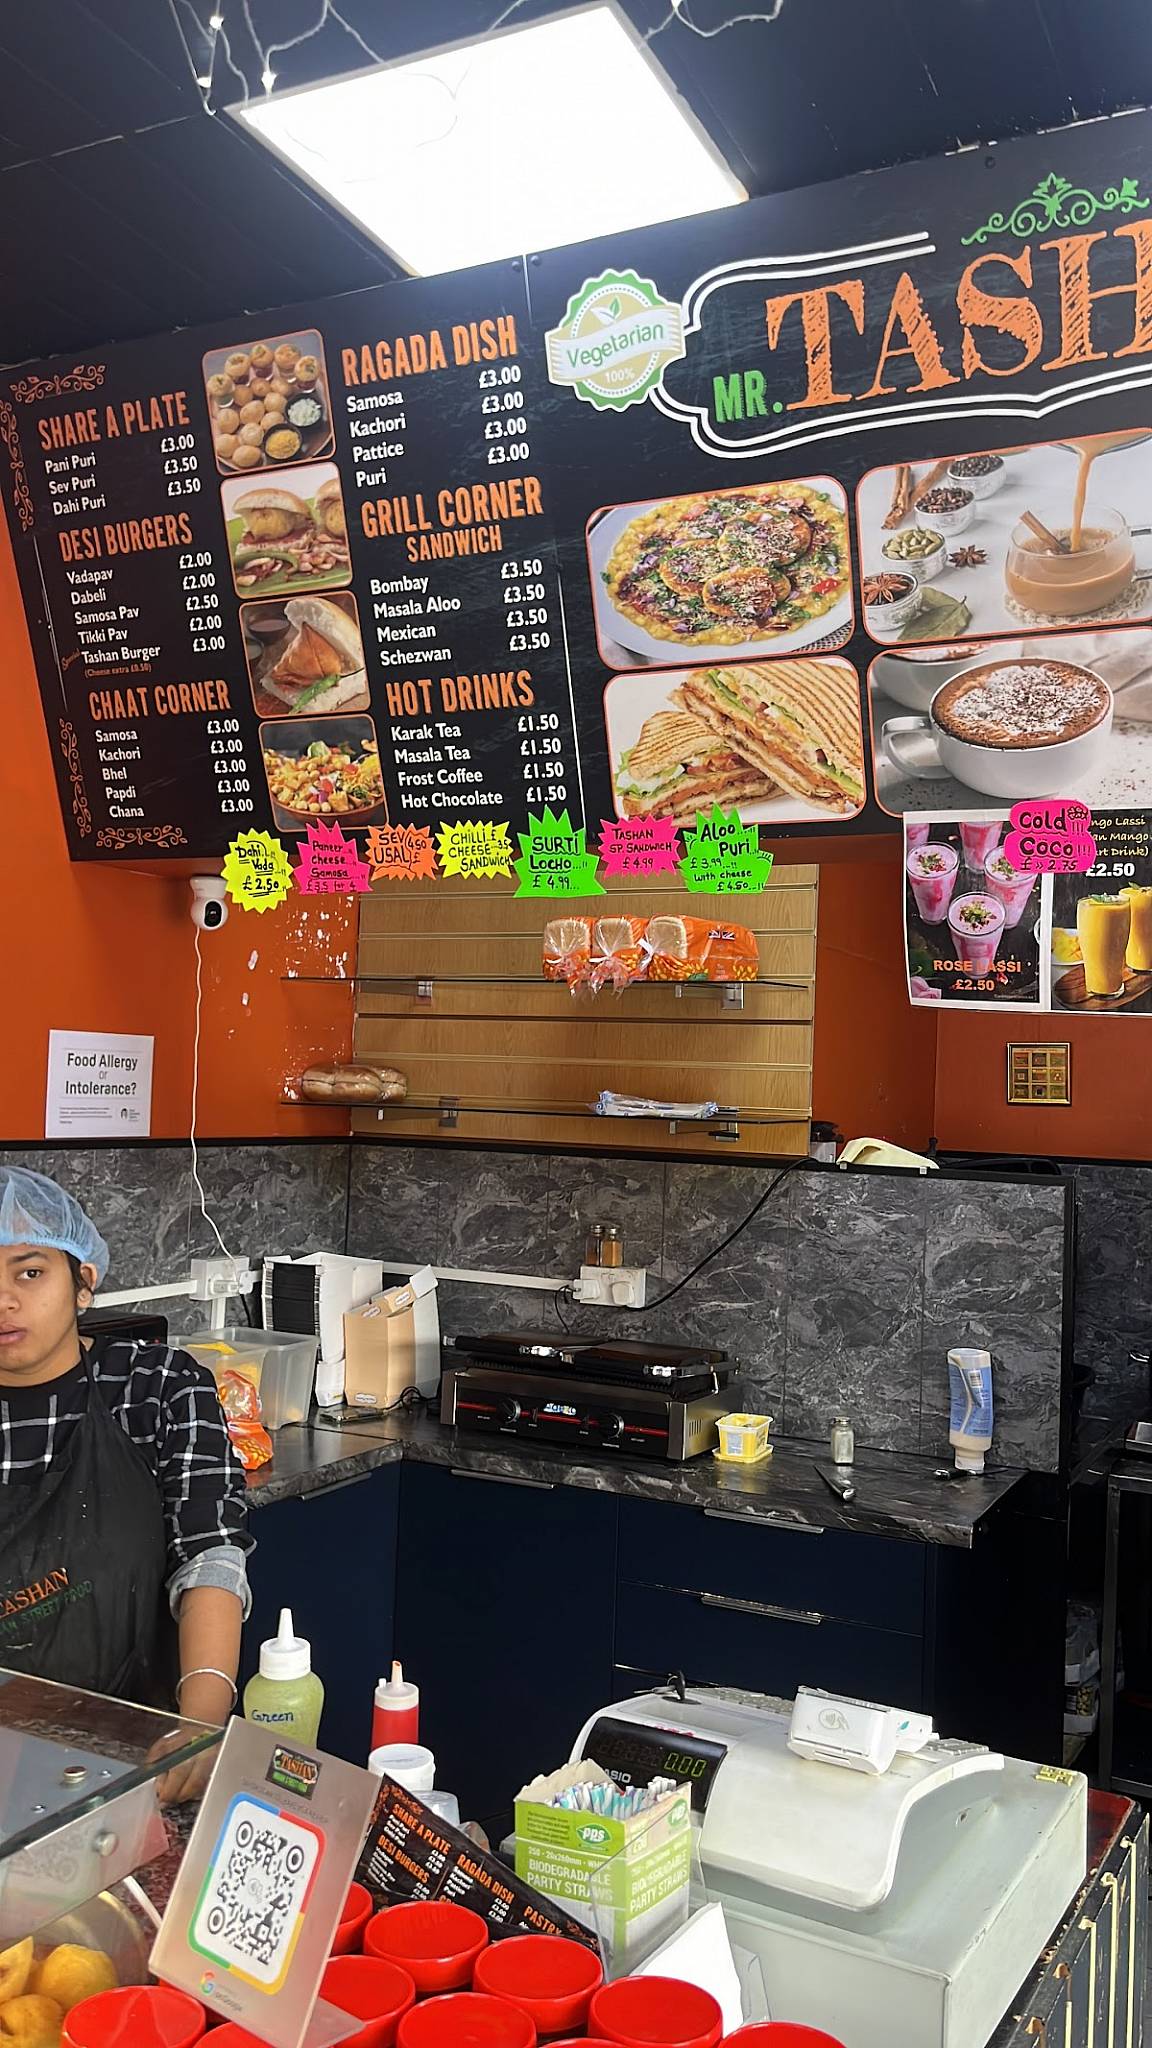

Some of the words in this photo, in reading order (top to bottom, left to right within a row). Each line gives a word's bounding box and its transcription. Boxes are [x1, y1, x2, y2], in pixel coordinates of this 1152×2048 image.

[341, 330, 448, 387] RAGADA
[452, 315, 518, 366] DISH
[568, 324, 664, 368] Vegetarian
[479, 365, 521, 389] £3.00
[605, 368, 635, 383] 100%
[346, 391, 404, 413] Samosa
[482, 391, 524, 415] £3.00
[712, 368, 784, 424] MR.
[37, 408, 101, 450] SHARE
[107, 406, 120, 438] A
[122, 391, 190, 436] PLATE
[350, 413, 407, 438] Kachori
[485, 417, 527, 440] £3.00
[161, 434, 195, 452] £3.00
[353, 442, 404, 463] Pattice
[45, 459, 70, 474] Pani
[72, 452, 97, 471] Puri
[488, 442, 530, 465] £3.00
[164, 456, 198, 475] £3.50
[49, 481, 70, 495] Sev
[72, 475, 96, 491] Puri
[168, 478, 201, 496] £3.50
[356, 468, 387, 488] Puri
[53, 499, 80, 516] Dahi
[81, 494, 106, 512] Puri
[361, 494, 433, 539] GRILL
[438, 476, 544, 528] CORNER
[58, 527, 102, 562] DESI
[104, 512, 193, 556] BURGERS
[406, 524, 502, 563] SANDWICH
[179, 552, 212, 569] £2.00
[501, 558, 543, 580] £3.50
[67, 568, 113, 585] Vadapav
[182, 572, 215, 590] £2.00
[370, 576, 429, 595] Bombay
[71, 589, 107, 605] Dabeli
[186, 594, 219, 611] £2.50
[503, 583, 545, 604] £3.50
[75, 609, 117, 625] Samosa
[120, 607, 139, 621] Pav
[374, 601, 423, 619] Masala
[426, 596, 461, 614] Aloo
[189, 615, 222, 632] £2.00
[507, 607, 548, 628] £3.50
[78, 630, 106, 645] Tikki
[108, 629, 128, 643] Pav
[377, 624, 436, 643] Mexican
[510, 632, 551, 652] £3.50
[193, 636, 225, 652] £3.00
[81, 650, 119, 664] Tashan
[121, 646, 160, 661] Burger
[380, 648, 452, 667] Schezwan
[88, 687, 149, 721] CHAAT
[154, 679, 232, 716] CORNER
[386, 678, 433, 717] HOT
[441, 669, 535, 713] DRINKS
[207, 719, 240, 735] £3.00
[391, 725, 433, 742] Karak
[435, 722, 462, 738] Tea
[518, 713, 559, 733] £1.50
[95, 730, 138, 742] Samosa
[99, 747, 141, 762] Kachori
[210, 739, 243, 754] £3.00
[394, 747, 443, 764] Masala
[444, 745, 471, 761] Tea
[520, 737, 562, 756] £1.50
[102, 768, 127, 781] Bhel
[214, 759, 247, 774] £3.00
[523, 761, 564, 780] £1.50
[217, 779, 250, 794] £3.00
[398, 770, 434, 787] Frost
[437, 768, 484, 784] Coffee
[106, 786, 136, 802] Papdi
[401, 793, 430, 809] Hot
[432, 790, 503, 807] Chocolate
[526, 785, 567, 803] £1.50
[109, 805, 144, 819] Chana
[221, 799, 254, 813] £3.00
[1092, 818, 1112, 829] ngo
[1116, 815, 1146, 826] Lassi
[379, 832, 405, 845] SEV
[612, 828, 653, 840] TASHAN
[1110, 833, 1148, 843] Mango
[374, 846, 410, 864] USAL
[448, 844, 491, 858] CHEESE
[1111, 846, 1148, 856] Drink)
[694, 872, 716, 881] with
[720, 869, 752, 879] cheese
[933, 960, 973, 971] ROSE
[955, 979, 994, 990] £2.50
[67, 1053, 96, 1067] Food
[99, 1054, 138, 1071] Allergy
[65, 1081, 137, 1095] Intolerance?
[252, 1709, 294, 1723] Green
[664, 1752, 707, 1777] 0.00
[604, 1768, 631, 1783] ASIO
[392, 1803, 419, 1830] SHARE
[416, 1824, 424, 1836] A
[423, 1829, 452, 1855] PLATE
[378, 1834, 397, 1856] DESI
[395, 1849, 430, 1884] BURGERS
[457, 1854, 493, 1888] RAGADA
[492, 1881, 515, 1904] DISH
[527, 1872, 562, 1891] PARTY
